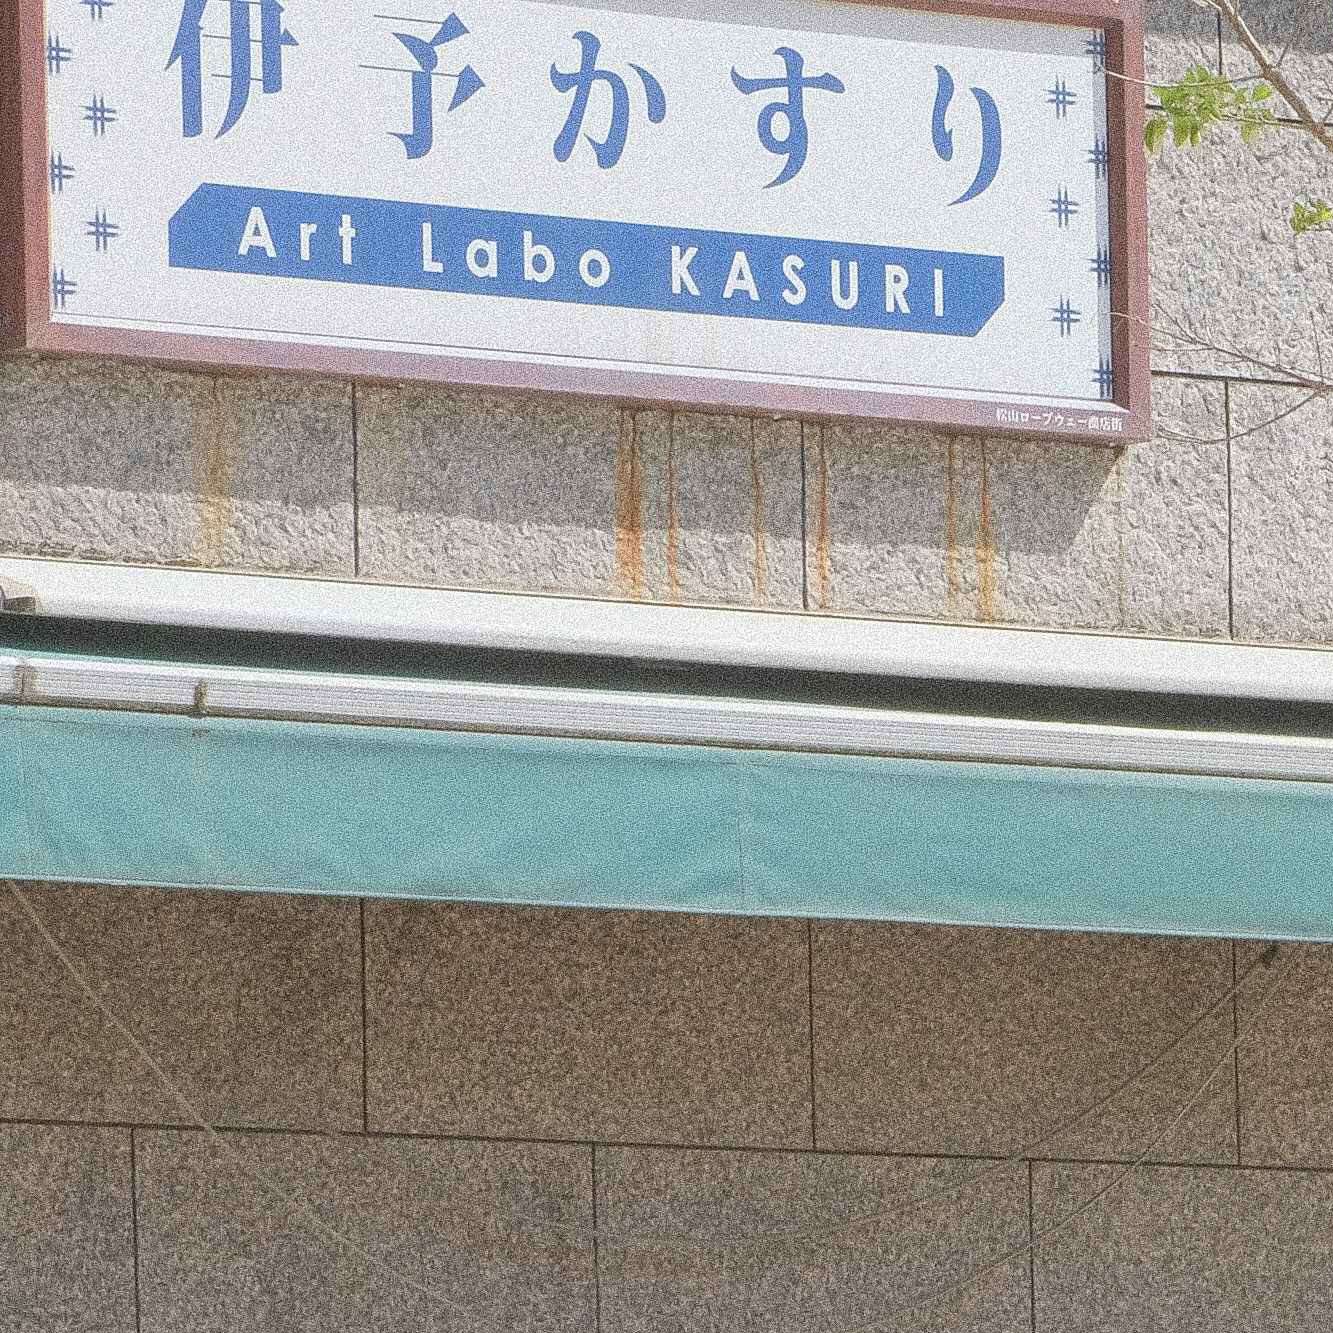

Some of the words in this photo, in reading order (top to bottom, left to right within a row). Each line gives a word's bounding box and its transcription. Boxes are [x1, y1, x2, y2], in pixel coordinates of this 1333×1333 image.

[165, 0, 1001, 206] 伊予かすり
[238, 206, 356, 265] Art
[421, 222, 611, 288] Labo
[670, 245, 944, 317] KASURI
[996, 408, 1123, 432] 松山ロープウェー商店街
